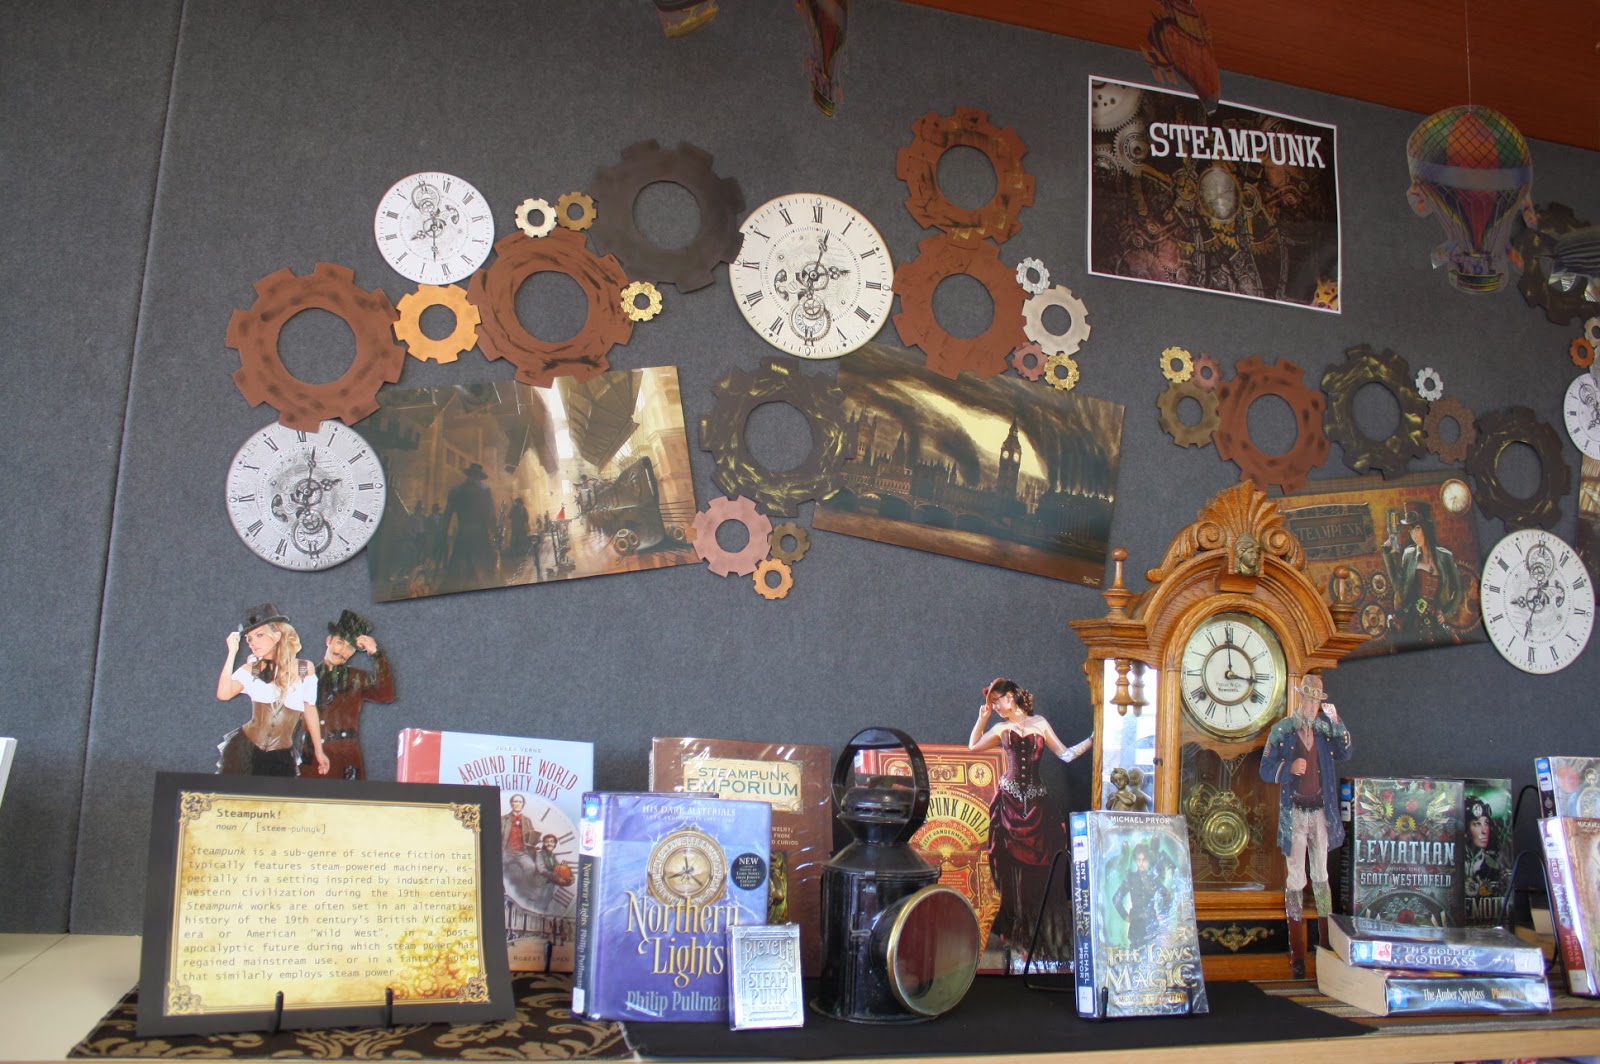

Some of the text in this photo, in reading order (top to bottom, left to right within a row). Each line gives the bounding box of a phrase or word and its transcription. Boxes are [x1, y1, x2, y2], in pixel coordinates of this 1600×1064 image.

[1150, 122, 1326, 169] STEAMPUNK
[458, 754, 578, 790] AROUND THE WORLD
[699, 767, 790, 782] STEAMPUNK
[494, 774, 532, 791] EIGHTY
[535, 778, 561, 801] DAYS
[686, 778, 798, 796] EMPORIUM
[217, 809, 281, 819] Steampunk!
[661, 805, 686, 815] DARK
[687, 807, 736, 816] MATERIALS
[927, 797, 990, 838] PUNK BIBLE
[1110, 816, 1143, 824] MICHAEL
[190, 846, 246, 856] Steampunk
[254, 848, 264, 856] is
[284, 848, 336, 858] sub-genre
[343, 849, 355, 858] of
[361, 850, 401, 858] science
[407, 850, 445, 859] fiction
[450, 851, 472, 860] that
[1355, 839, 1456, 866] LEVIATHAN
[189, 860, 245, 872] typically
[254, 861, 301, 870] features
[394, 863, 448, 873] machinery,
[739, 857, 759, 865] NEW
[187, 875, 238, 884] pecially
[246, 875, 257, 883] in
[276, 876, 319, 885] setting
[326, 876, 372, 885] inspired
[378, 876, 389, 885] by
[397, 877, 472, 885] industrialized
[1360, 872, 1452, 887] SCOTT WESTERFELD
[242, 889, 315, 897] civilization
[326, 890, 360, 898] during
[186, 902, 244, 912] Steampunk
[250, 902, 281, 910] works
[314, 902, 344, 910] often
[377, 902, 388, 910] in
[412, 902, 474, 910] alternative
[185, 916, 474, 926] history of the 19th century's British Victorian
[624, 890, 739, 939] Northern
[246, 930, 296, 938] American
[404, 928, 414, 936] in
[184, 944, 253, 954] apocalyptic
[263, 943, 300, 952] future
[307, 942, 342, 952] during
[350, 942, 380, 950] which
[424, 944, 450, 952] power
[184, 958, 235, 968] regained
[244, 958, 306, 966] mainstream
[314, 958, 338, 966] use,
[400, 954, 438, 964] fantasy
[450, 954, 476, 962] world
[638, 937, 725, 989] Lights
[1404, 954, 1477, 968] COMPASS
[184, 972, 208, 980] that
[216, 971, 273, 980] similarly
[280, 970, 322, 980] employs
[366, 970, 399, 978] power.
[749, 971, 789, 988] STEAM
[750, 988, 788, 1005] PUNK
[1422, 988, 1434, 1001] The
[1433, 987, 1457, 1002] Amber
[1458, 987, 1485, 1004] Spyglass
[626, 990, 668, 1017] Philip
